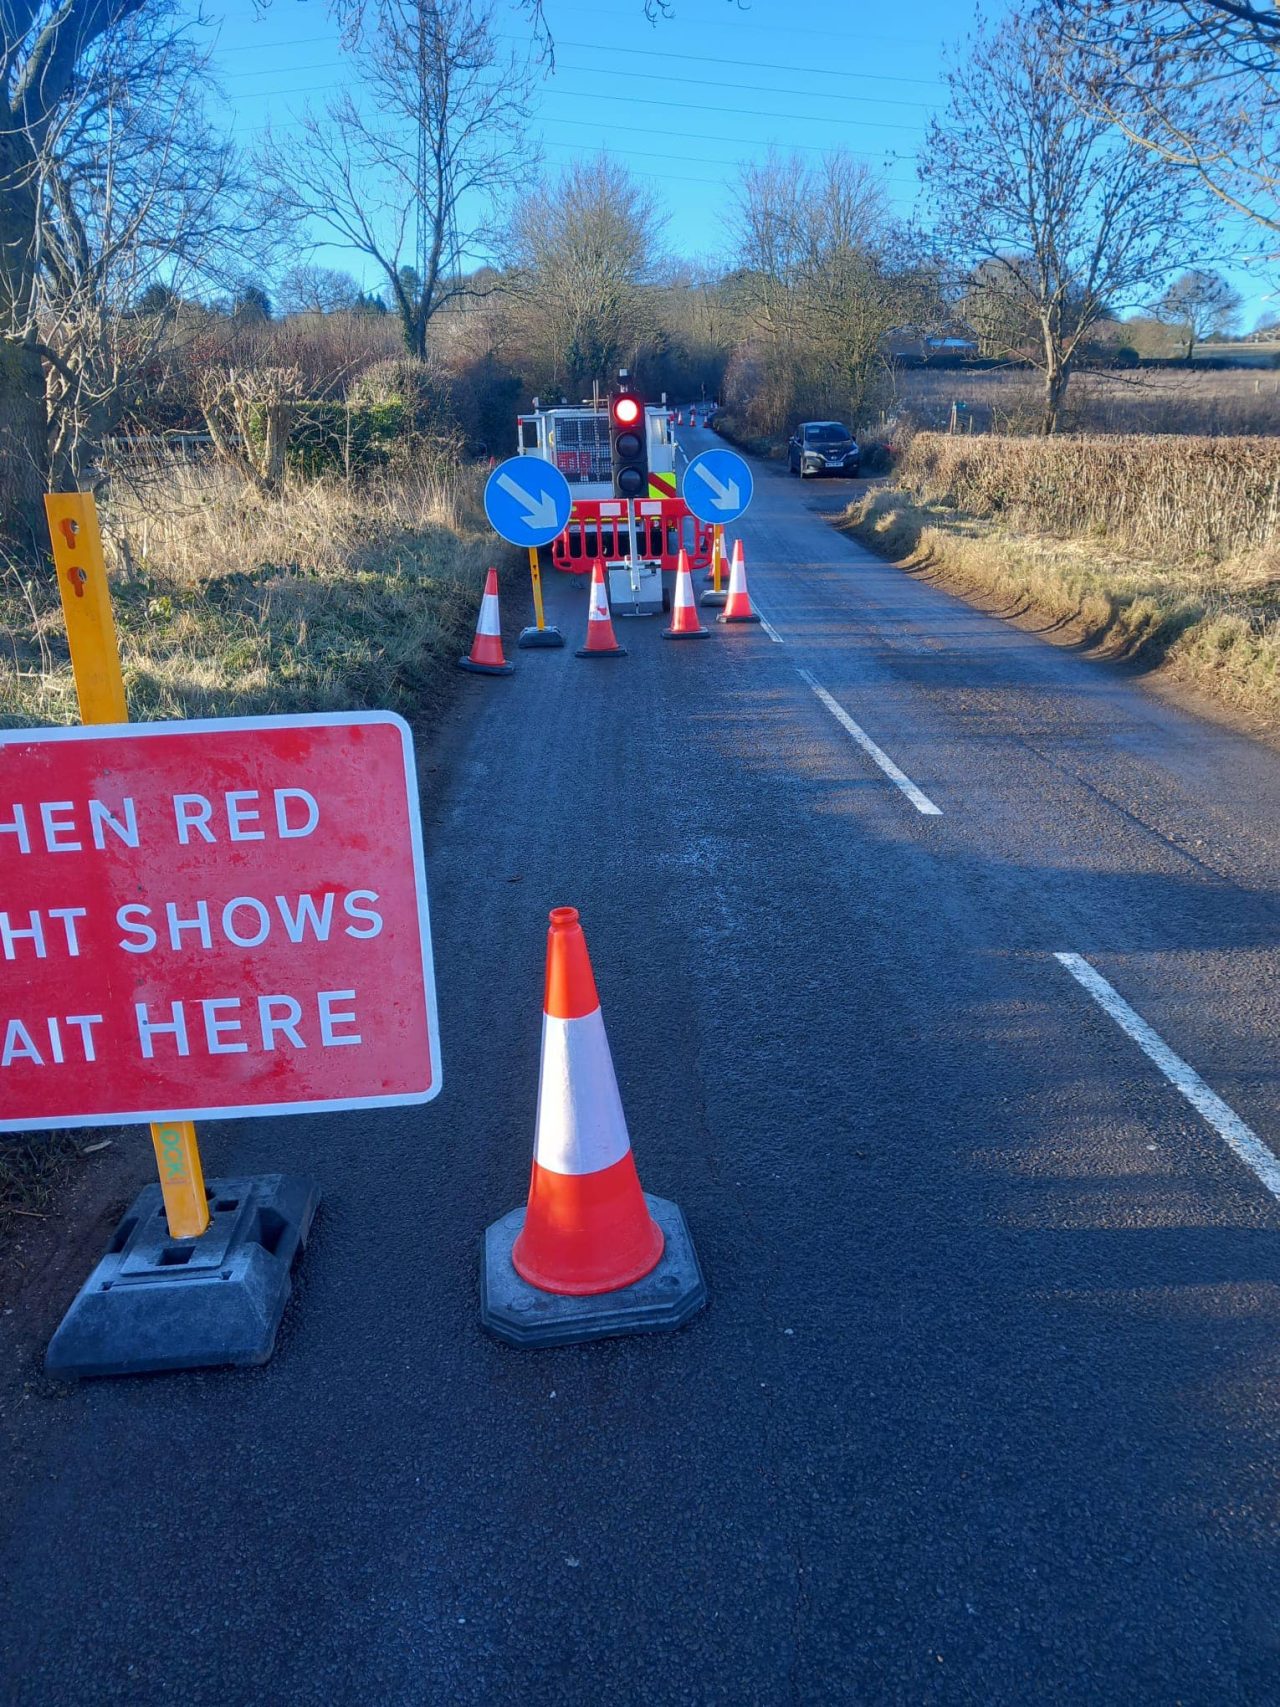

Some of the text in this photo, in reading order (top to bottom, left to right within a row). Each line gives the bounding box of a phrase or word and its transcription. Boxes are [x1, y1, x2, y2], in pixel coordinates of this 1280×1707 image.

[173, 787, 320, 845] RED
[0, 889, 384, 960] HT SHOWS
[0, 989, 363, 1067] AIT HERE
[157, 1123, 187, 1179] OCK
